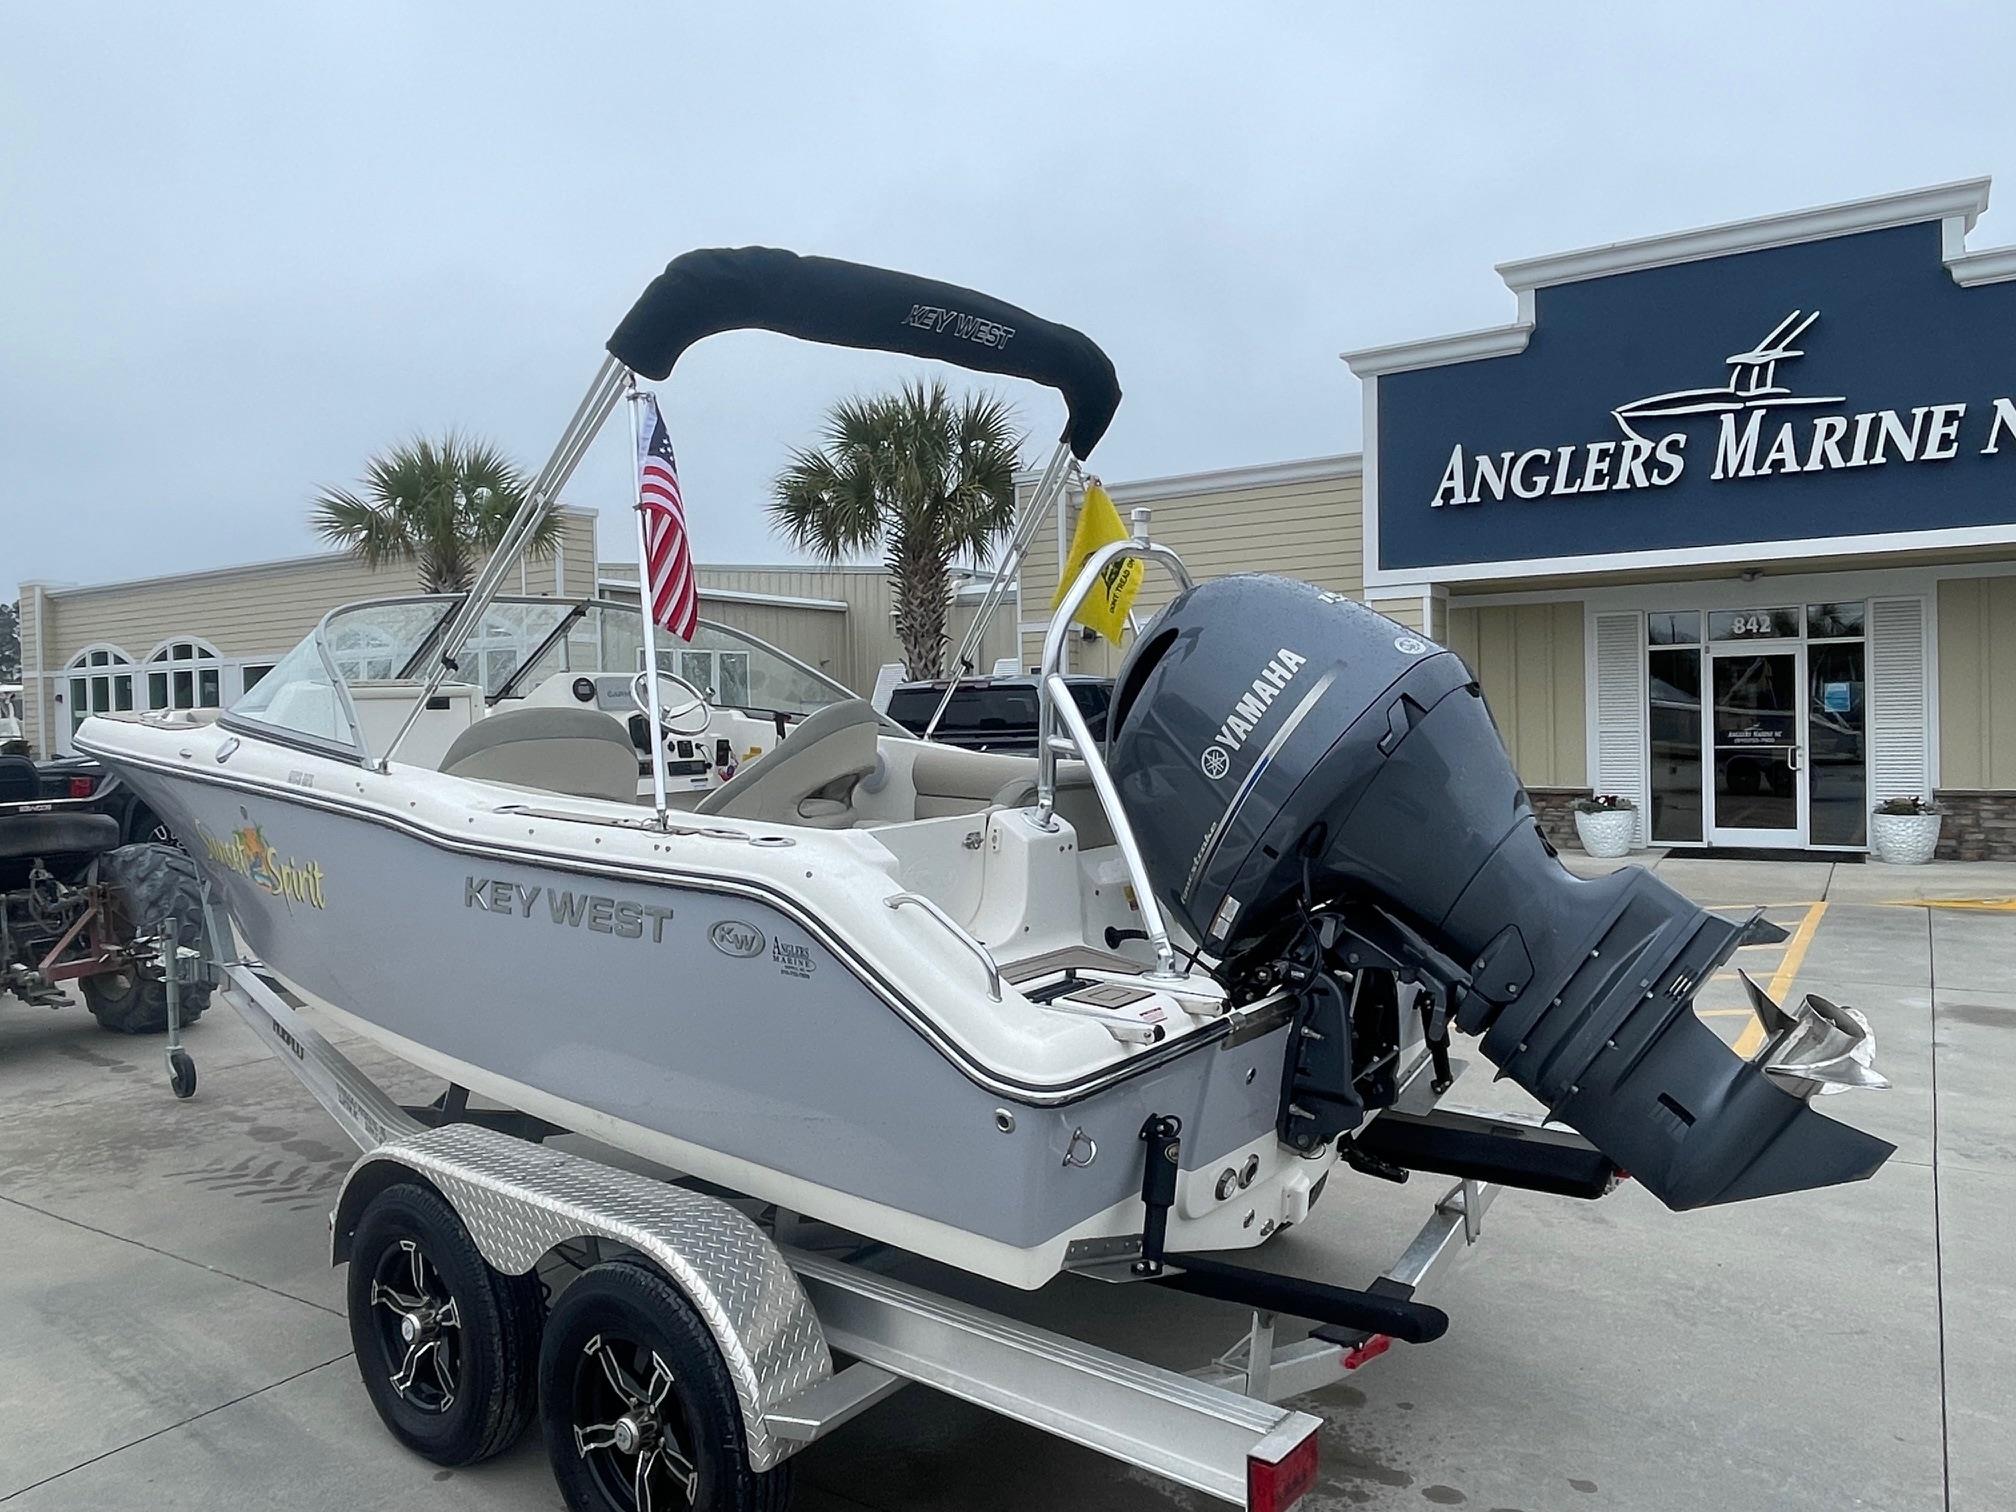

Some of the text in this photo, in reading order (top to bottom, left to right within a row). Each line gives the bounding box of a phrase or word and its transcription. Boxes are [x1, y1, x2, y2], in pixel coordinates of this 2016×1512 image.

[901, 304, 1016, 350] KEY WEST
[1430, 433, 1688, 508] ANGLERS
[1710, 402, 1967, 480] MARINE
[1115, 569, 1131, 592] TREAD
[1733, 615, 1771, 634] 842
[1215, 648, 1307, 751] YAMAHA
[266, 846, 326, 917] Spirit
[464, 875, 674, 944] KEY WEST
[719, 926, 756, 951] KW
